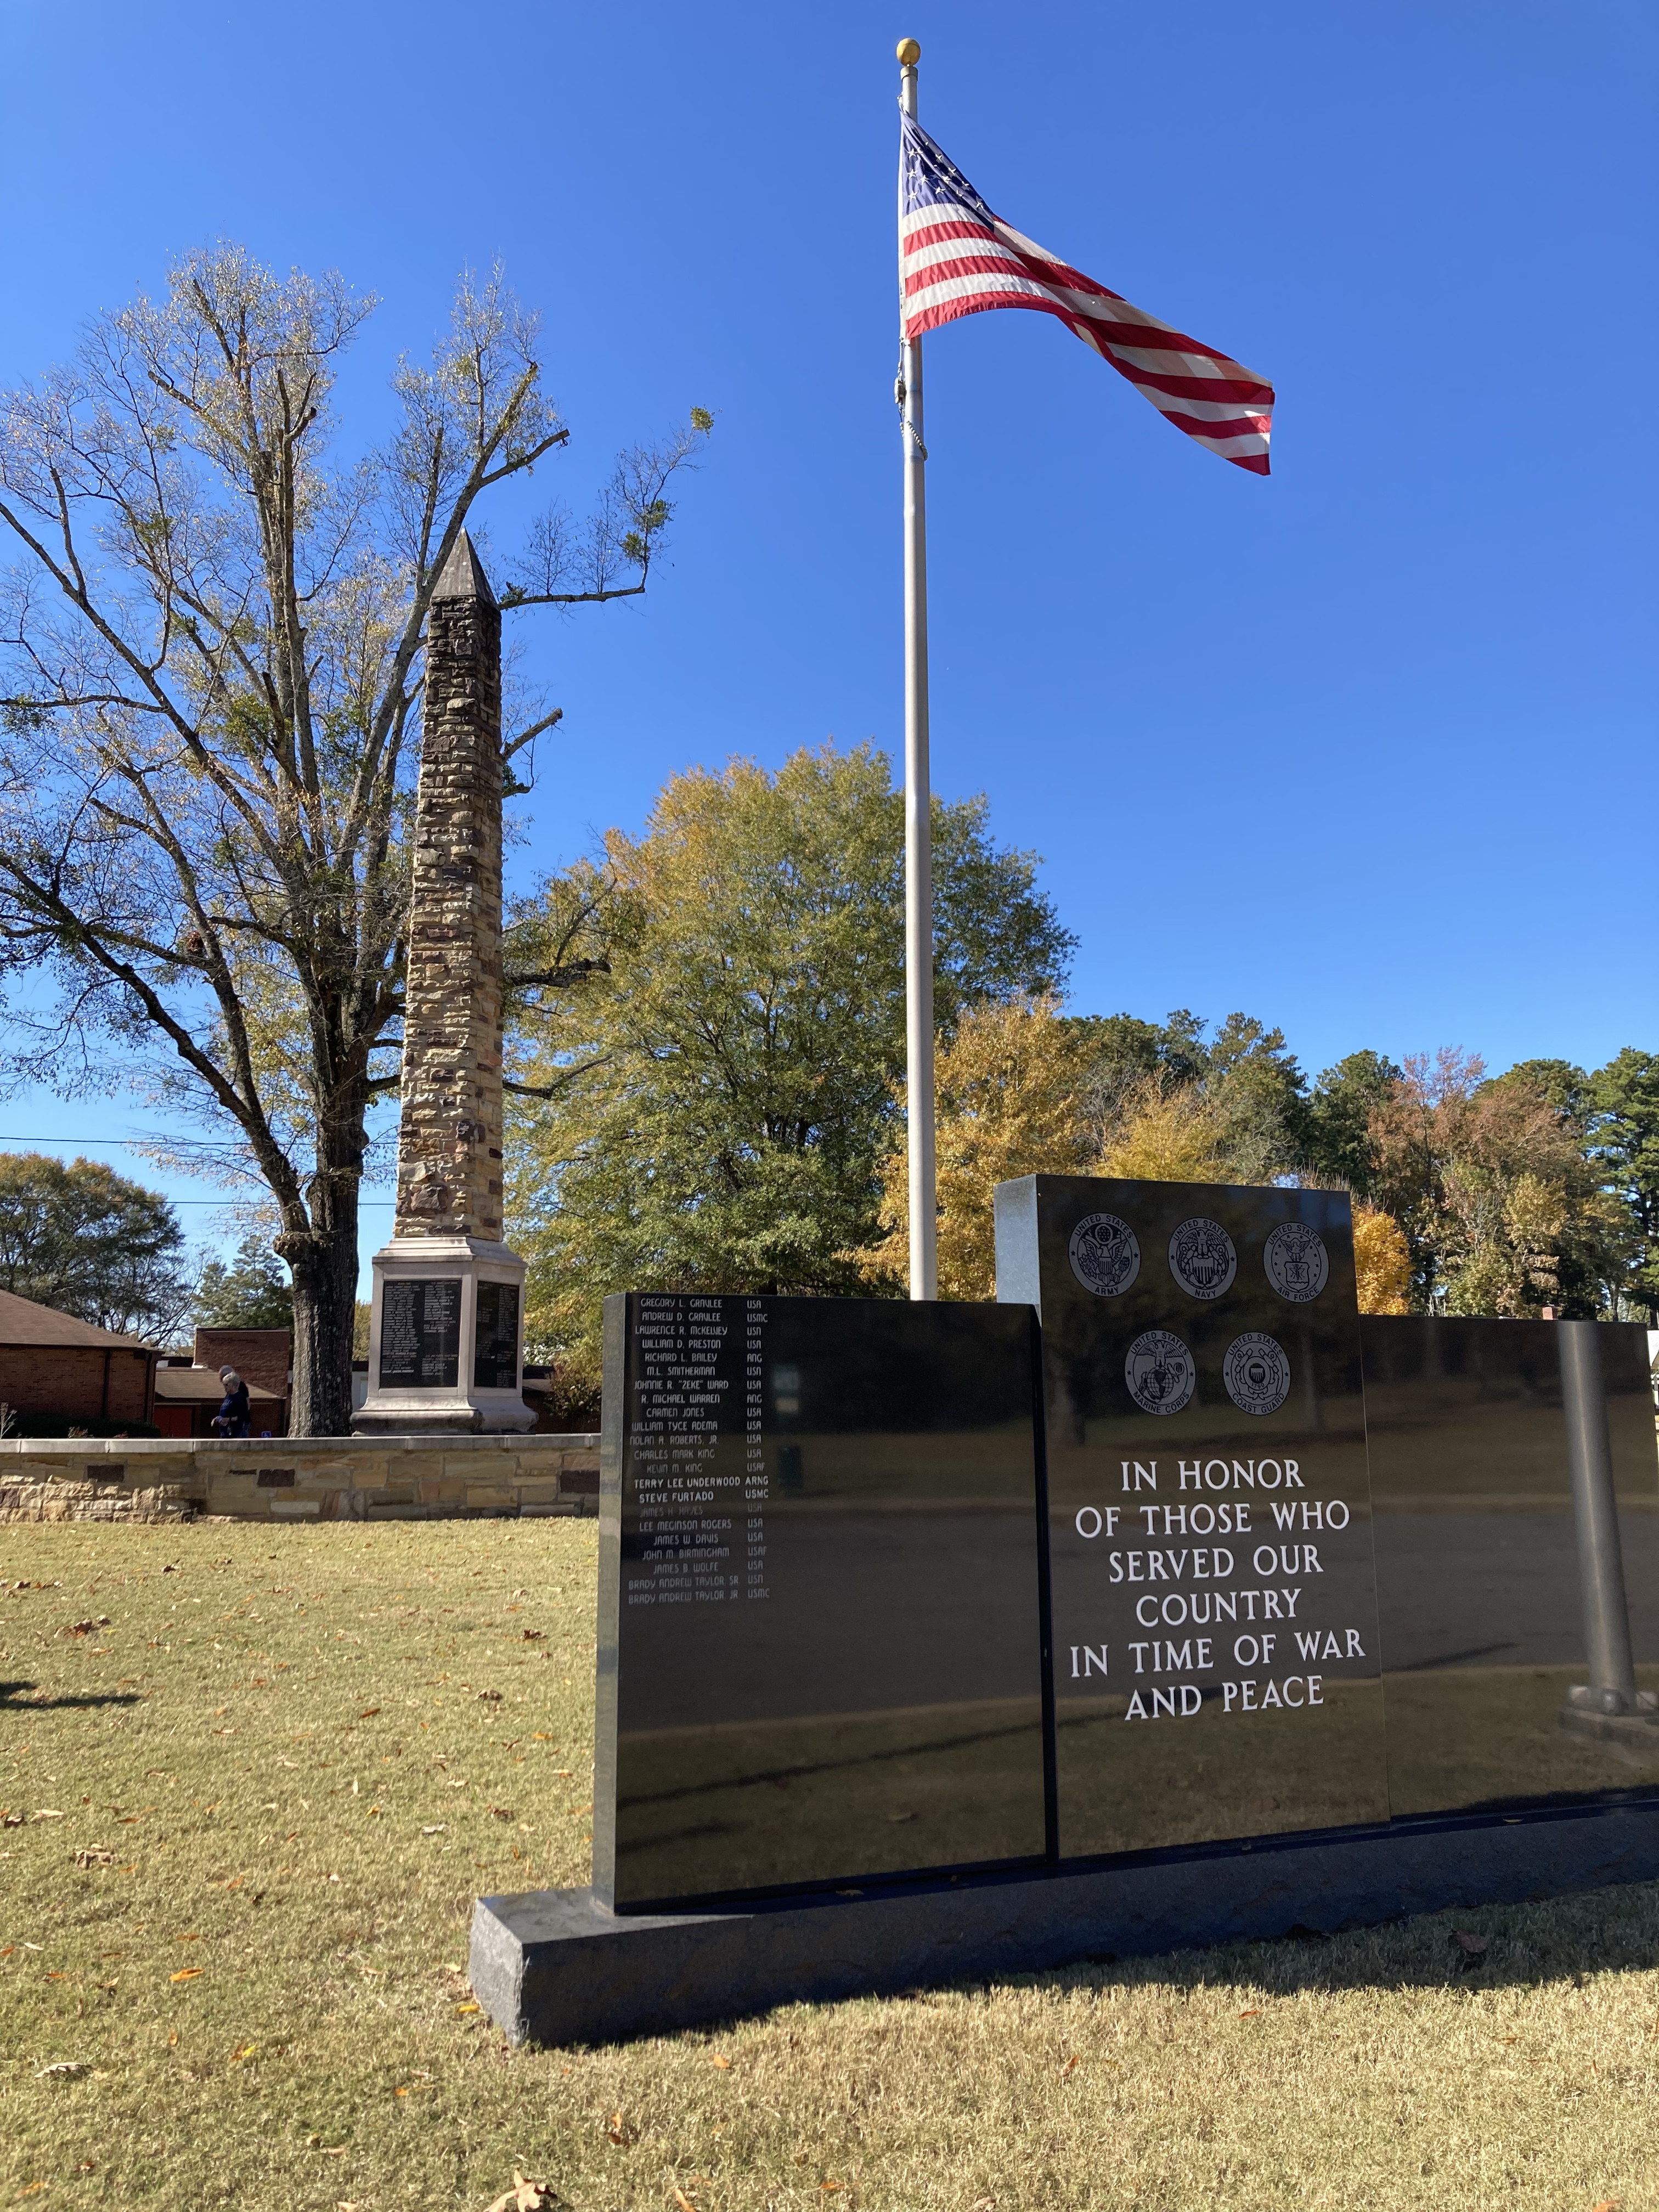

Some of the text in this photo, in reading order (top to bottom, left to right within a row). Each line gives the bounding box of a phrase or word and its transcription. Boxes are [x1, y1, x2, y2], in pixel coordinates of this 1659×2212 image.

[1075, 1215, 1132, 1239] UNITED STATES
[1173, 1220, 1229, 1243] UNITED STATES
[1268, 1224, 1322, 1247] UNITED STATES
[1195, 1289, 1217, 1298] NAVY
[1277, 1286, 1319, 1301] AIR FORCE
[641, 1298, 761, 1309] GREGORY L. GRAVLEE USA
[642, 1312, 768, 1323] ANDREW D. GRAVLEE USMC
[635, 1325, 675, 1335] LAWRENCE
[679, 1325, 686, 1335] R.
[747, 1327, 761, 1335] USN
[642, 1339, 761, 1349] WILLIAM D. PRESTON USA
[1131, 1332, 1188, 1356] UNITED STATES
[1228, 1334, 1283, 1356] UNITED STATES
[645, 1353, 677, 1363] RICHARD
[692, 1353, 717, 1363] BAILEY
[747, 1353, 762, 1363] ANG
[667, 1366, 715, 1376] SMITHERMAN
[747, 1367, 761, 1376] USN
[634, 1380, 663, 1390] JOHNNIE
[667, 1380, 675, 1390] R.
[708, 1380, 729, 1390] WARD
[747, 1380, 761, 1390] USA
[641, 1395, 762, 1404] R. MICHAEL WARREN ANG
[1133, 1391, 1189, 1413] MARINE CORPS
[1233, 1393, 1284, 1413] COAST GUARD
[646, 1408, 761, 1418] CARMEN JONES USA
[632, 1421, 761, 1432] WILLIAM TYCE ADEMA USA
[630, 1435, 654, 1445] NOLAN
[747, 1434, 761, 1444] USA
[634, 1448, 761, 1460] CHARLES MARK KING USA
[647, 1464, 668, 1474] KEVIN
[686, 1463, 702, 1473] KING
[747, 1462, 765, 1472] USAF
[1121, 1459, 1305, 1491] IN HONOR
[634, 1476, 768, 1489] TERRY LEE UNDERWOOD ARNG
[639, 1489, 769, 1504] STEVE FURTADO USMC
[640, 1507, 664, 1517] JAMES
[747, 1503, 761, 1513] USA
[640, 1518, 763, 1532] LEE MEGINSON ROGERS USA
[1075, 1500, 1350, 1539] OF THOSE WHO
[653, 1535, 679, 1546] JAMES
[696, 1534, 719, 1544] DAVIS
[747, 1532, 763, 1542] USA
[642, 1549, 663, 1561] JOHN
[679, 1547, 730, 1559] BIRMINGHAM
[748, 1546, 767, 1556] USAF
[653, 1564, 679, 1575] JAMES
[693, 1562, 719, 1572] WOLFE
[748, 1560, 763, 1570] USA
[1109, 1544, 1324, 1583] SERVED OUR
[629, 1580, 656, 1590] BRADY
[659, 1578, 691, 1589] ANDREW
[748, 1575, 763, 1584] USN
[629, 1594, 656, 1605] BRADY
[659, 1592, 691, 1603] ANDREW
[748, 1588, 770, 1599] USMC
[1136, 1588, 1301, 1627] COUNTRY
[1070, 1628, 1366, 1678] IN TIME OF WAR
[1125, 1674, 1324, 1721] AND PEACE
